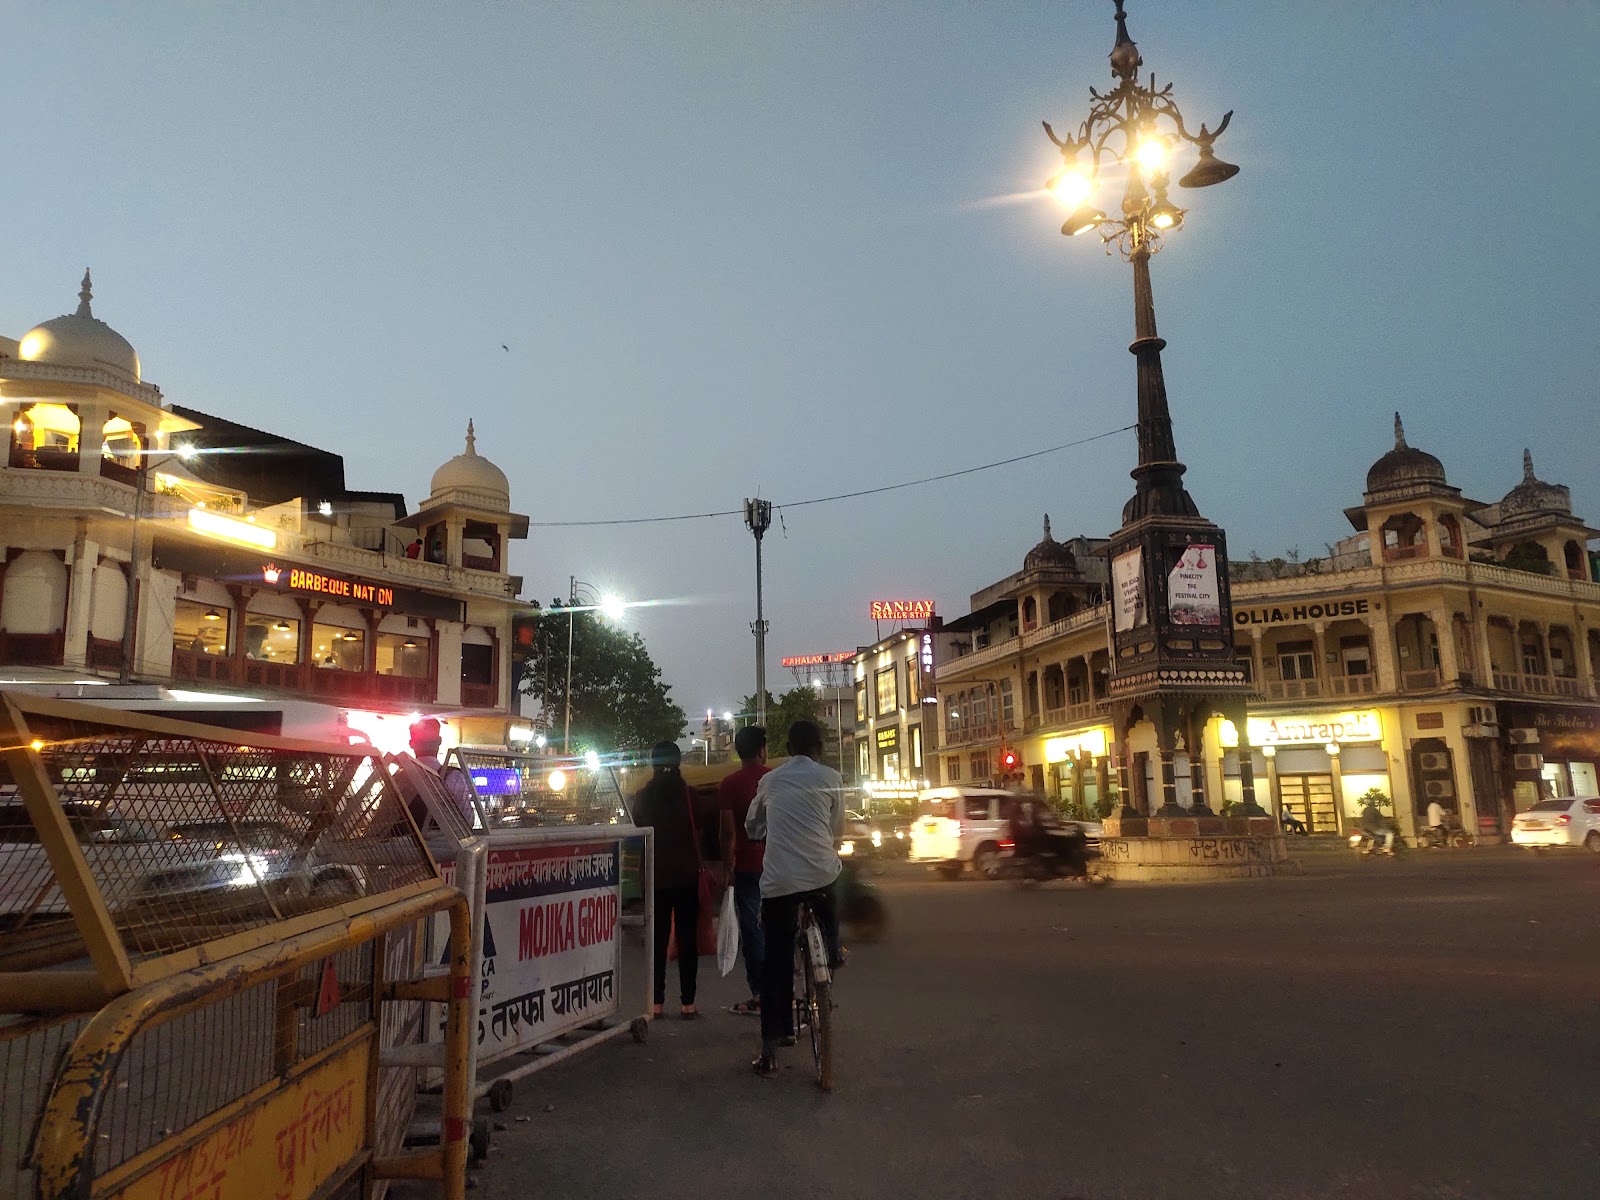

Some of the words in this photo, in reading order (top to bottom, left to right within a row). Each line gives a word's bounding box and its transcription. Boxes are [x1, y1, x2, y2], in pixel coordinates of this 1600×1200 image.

[290, 568, 350, 596] BARBEQUE
[353, 583, 393, 606] NATON
[871, 611, 908, 619] TEXTILE
[872, 601, 934, 612] SANJAY
[1292, 599, 1369, 620] HOUSE
[568, 847, 592, 886] पुलिस
[591, 852, 614, 881] जयपुर
[518, 900, 575, 962] MOJIKA
[578, 893, 618, 947] GROUP
[491, 988, 546, 1042] तरफा
[550, 969, 614, 1016] यातायात
